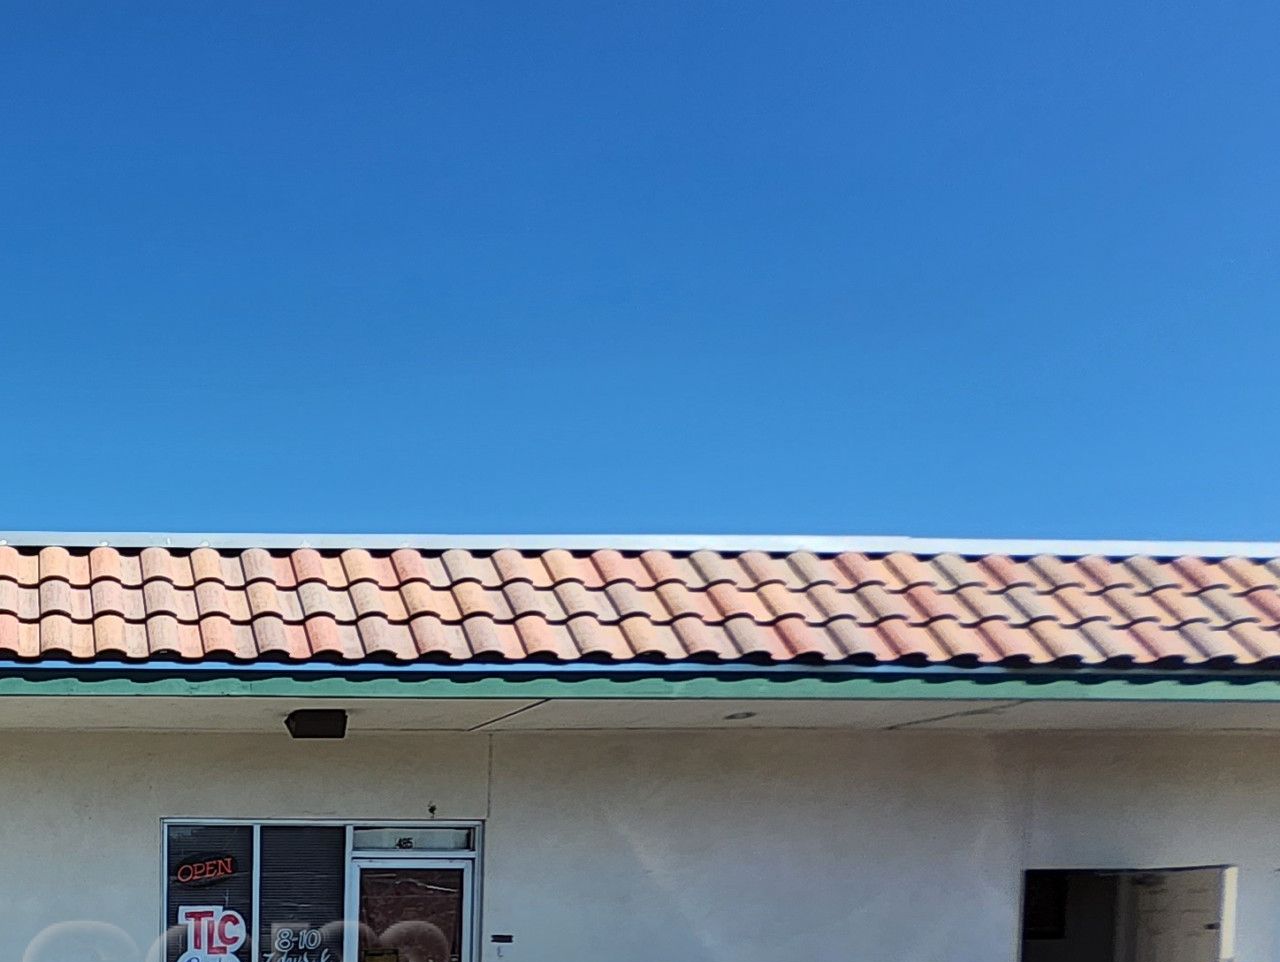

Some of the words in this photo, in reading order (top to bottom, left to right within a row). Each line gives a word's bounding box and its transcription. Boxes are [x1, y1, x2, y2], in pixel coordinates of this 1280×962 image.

[177, 857, 233, 882] OPEN
[184, 910, 240, 955] TLC
[274, 927, 322, 952] 8-10
